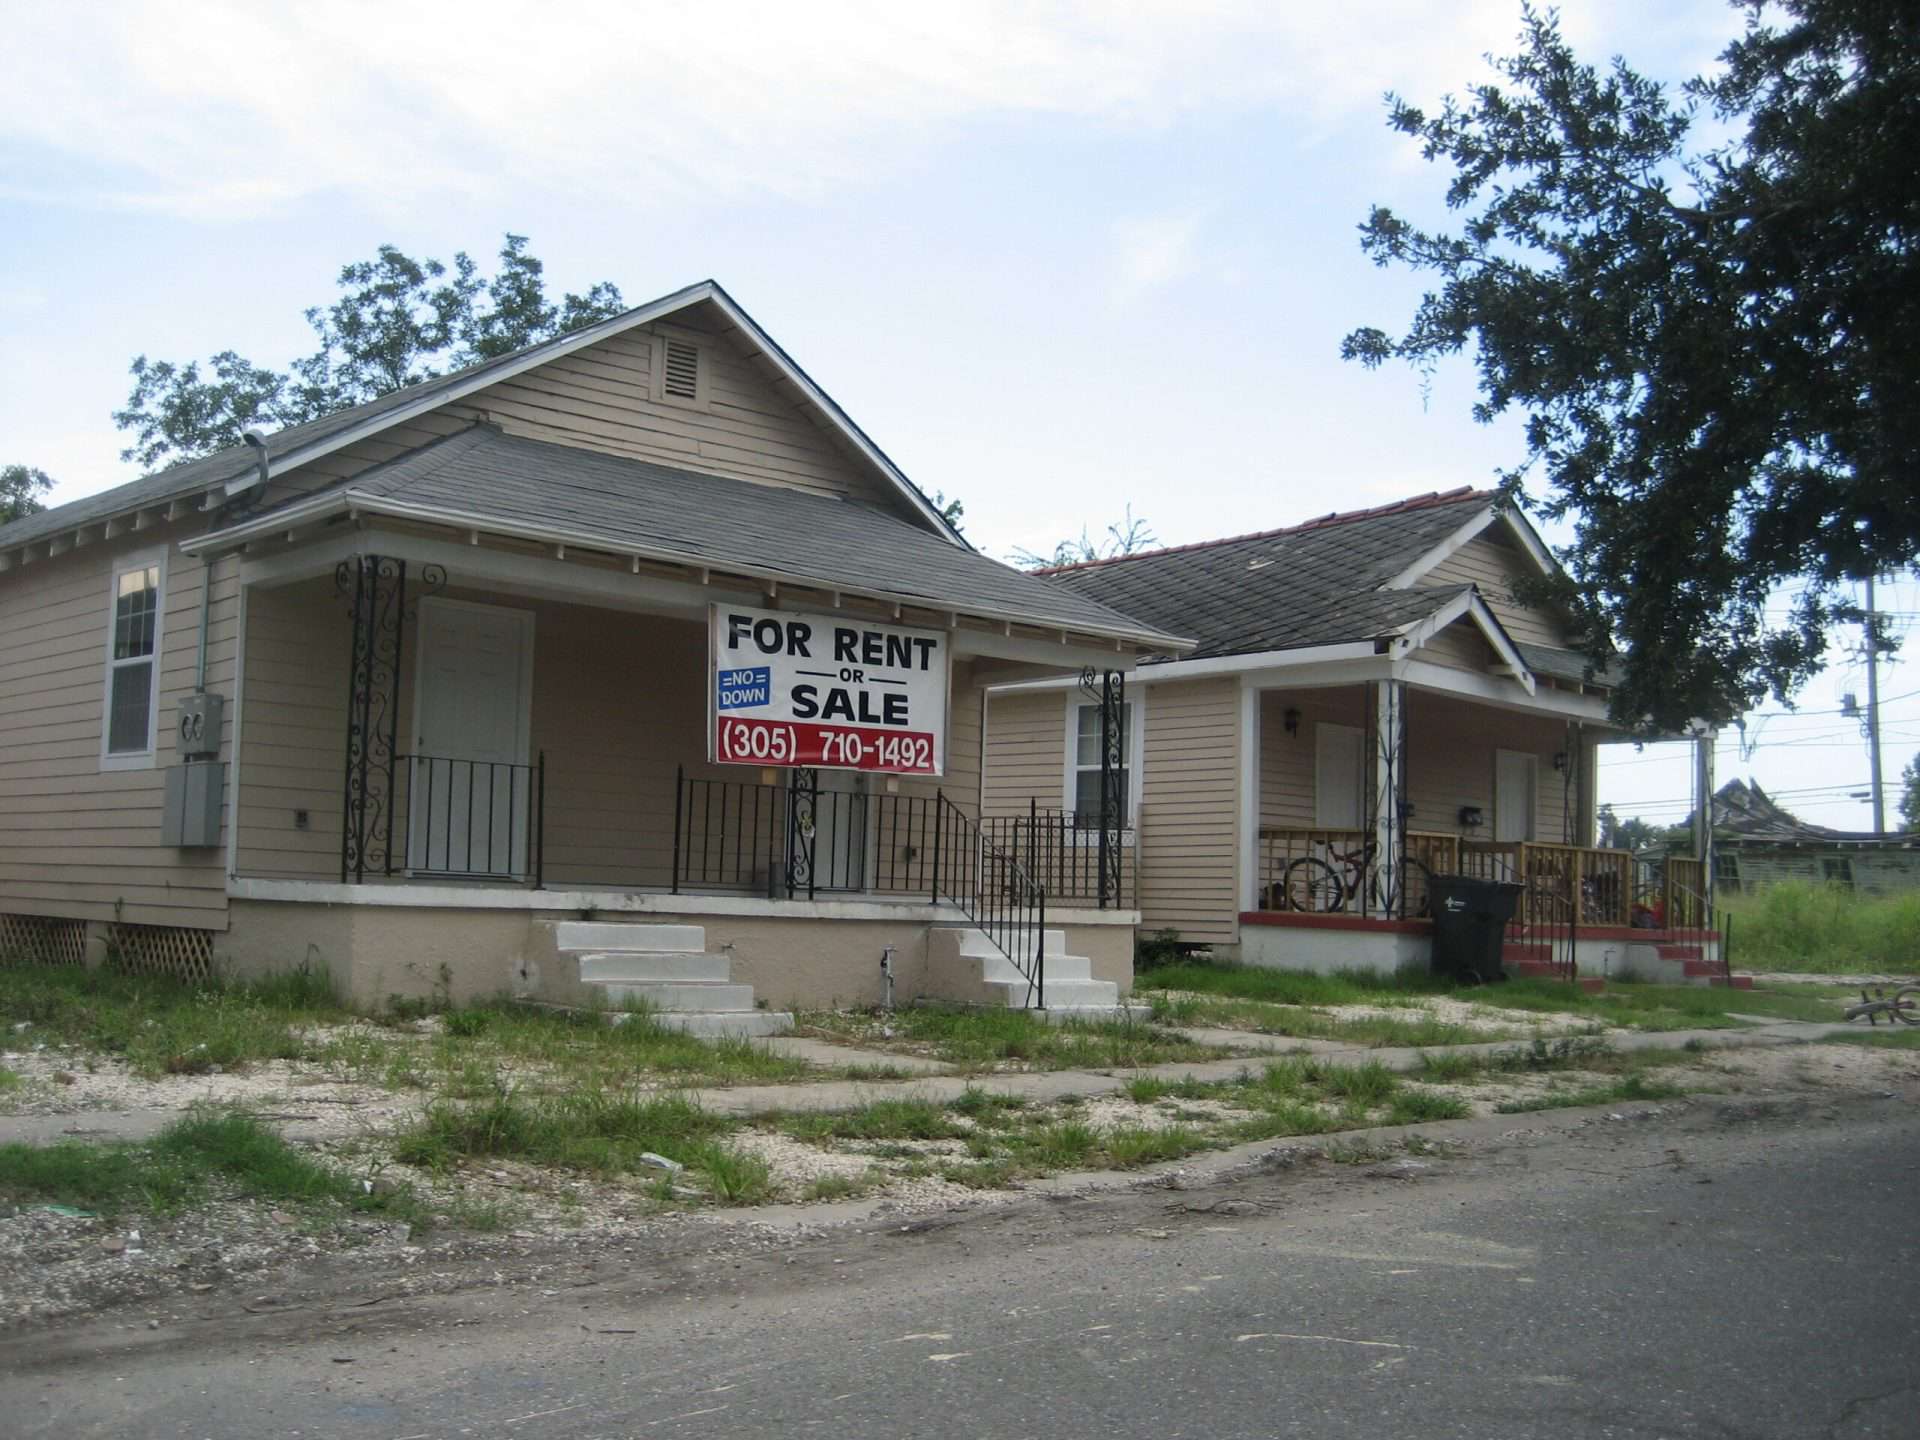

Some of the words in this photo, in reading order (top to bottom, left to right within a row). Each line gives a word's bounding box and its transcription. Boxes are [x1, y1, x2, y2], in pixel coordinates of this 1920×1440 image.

[728, 614, 812, 658] FOR
[834, 627, 938, 671] RENT
[722, 687, 766, 705] DOWN
[839, 668, 864, 683] OR
[791, 684, 909, 726] SALE
[723, 720, 797, 763] (305)
[818, 731, 930, 768] 710-1492
